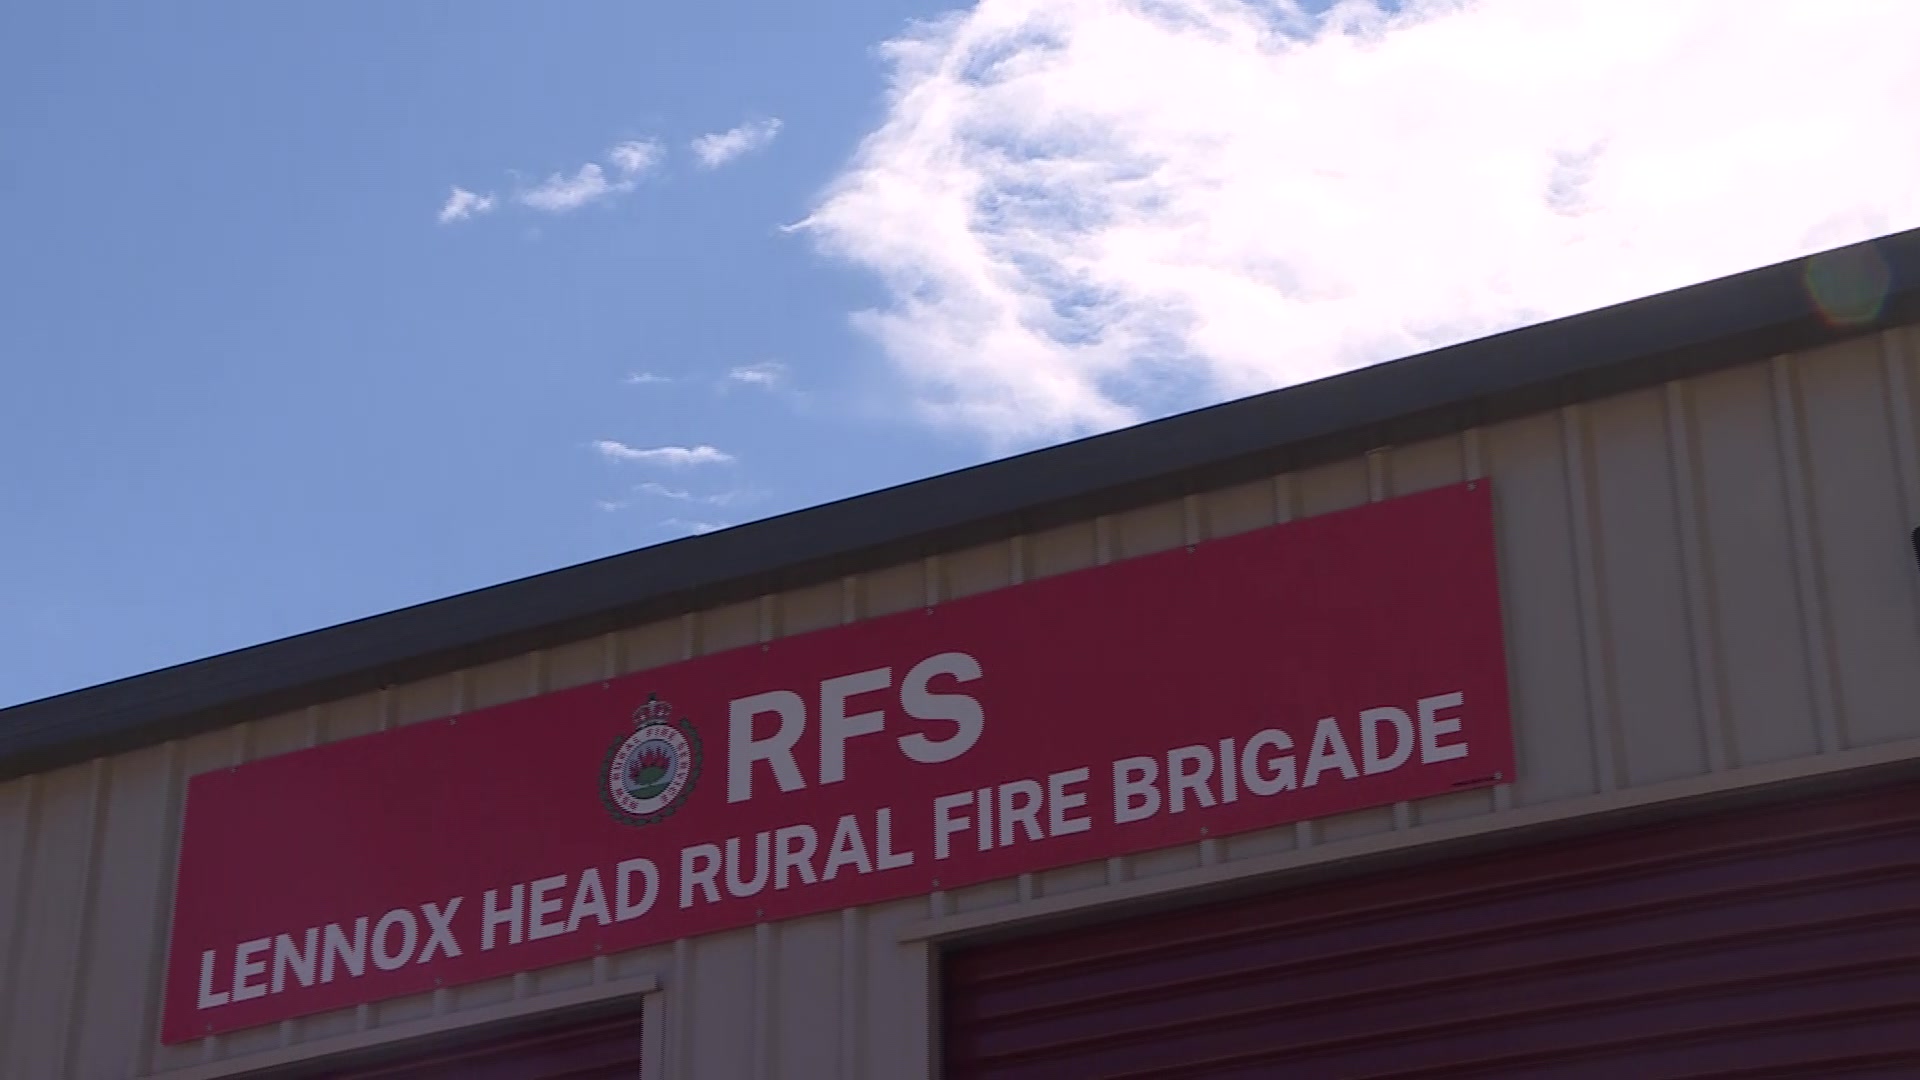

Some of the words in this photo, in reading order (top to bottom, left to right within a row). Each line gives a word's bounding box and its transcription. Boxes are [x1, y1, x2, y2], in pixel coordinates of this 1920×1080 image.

[646, 727, 677, 741] FIRE
[727, 652, 985, 803] RFS
[613, 736, 641, 781] RURAL
[660, 741, 688, 804] SERVICE
[614, 788, 639, 811] NSW
[197, 897, 463, 1009] LENNOX
[481, 859, 659, 950] HEAD
[679, 808, 914, 908] RURAL
[934, 768, 1091, 859] FIRE
[1113, 691, 1469, 823] BRIGADE
